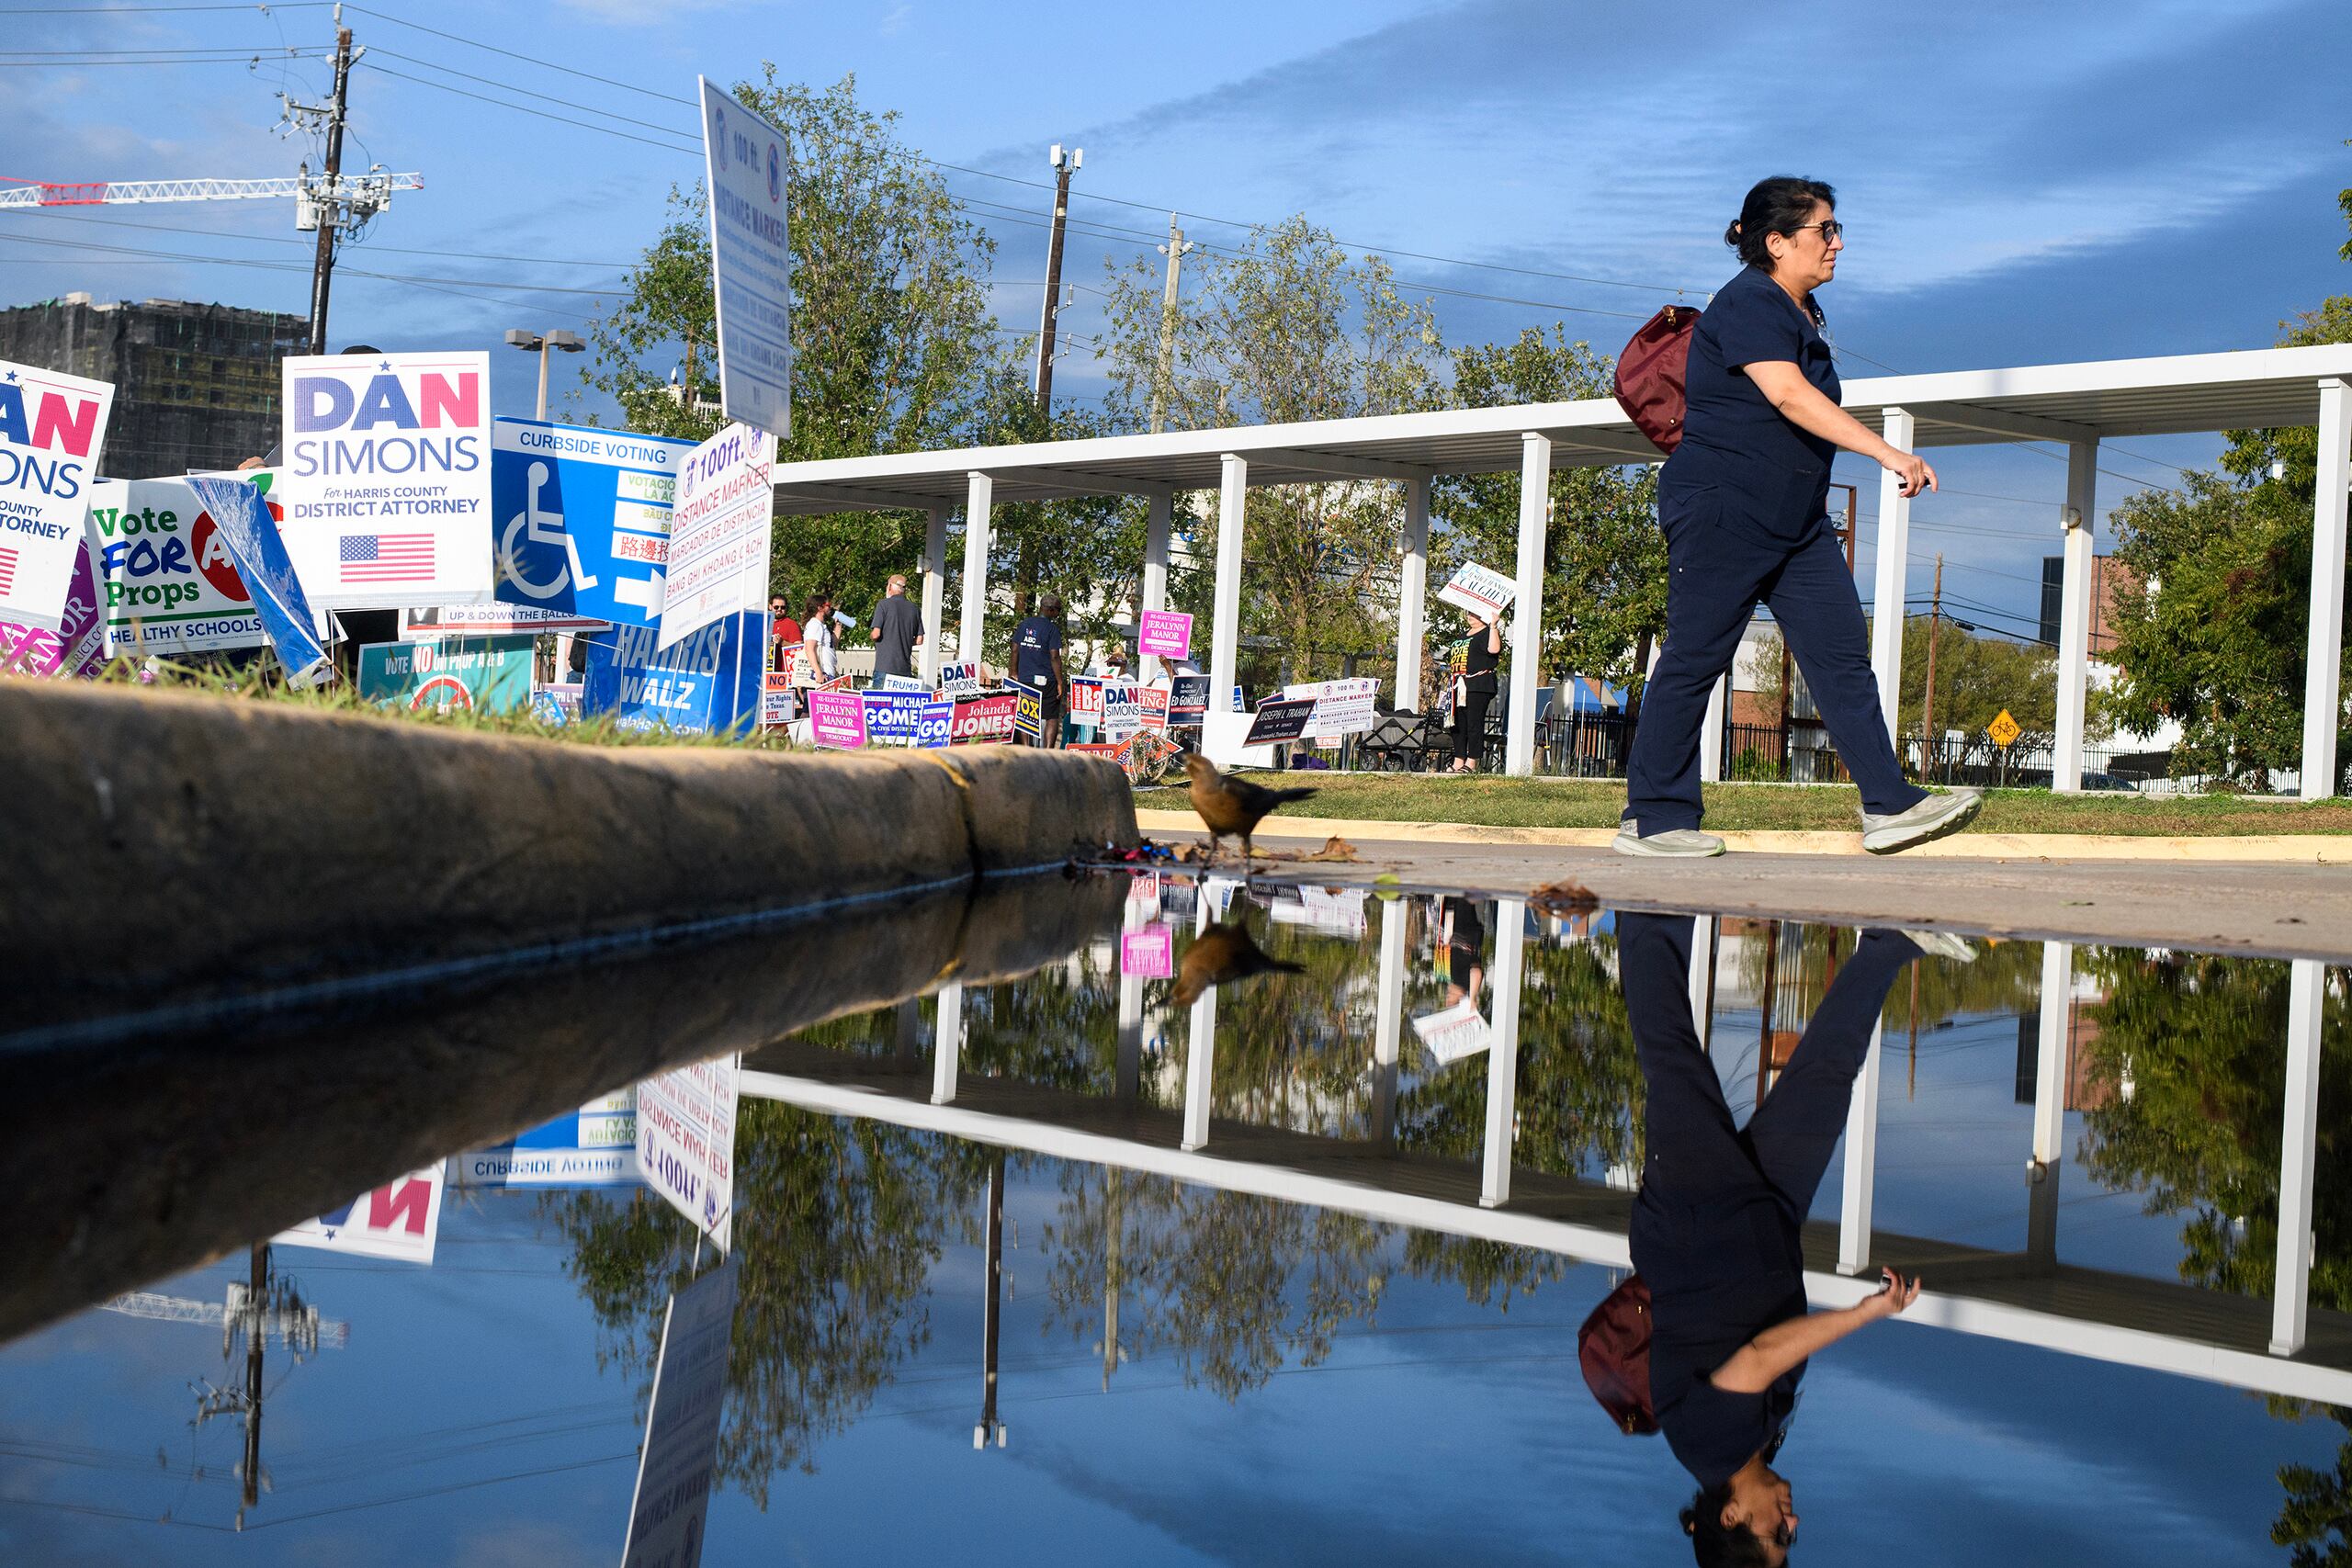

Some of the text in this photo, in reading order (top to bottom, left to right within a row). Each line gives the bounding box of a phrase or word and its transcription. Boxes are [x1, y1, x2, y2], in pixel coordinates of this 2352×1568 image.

[733, 130, 748, 166] 100
[752, 207, 786, 250] MARKER
[294, 373, 480, 433] DAN
[294, 435, 480, 477] SIMONS
[520, 432, 667, 464] CURBSIDE VOTING
[344, 488, 390, 499] HARRIS
[393, 486, 448, 498] COUNTY
[644, 490, 658, 501] LA
[673, 487, 719, 533] DISTANCE
[721, 462, 770, 502] MARKER
[294, 499, 480, 518] DISTRICT ATTORNEY
[92, 507, 178, 536] Vote
[671, 530, 709, 563] MARCADOR
[709, 521, 722, 540] DE
[723, 502, 766, 536] DISTANCIA
[99, 536, 192, 580] FOR
[687, 569, 701, 586] GHI
[104, 581, 200, 610] Props
[449, 609, 581, 621] UP & DOWN THE BALL
[110, 626, 180, 644] HEALTHY
[186, 617, 262, 638] SCHOOLS
[1146, 620, 1186, 632] JERALYNN
[1150, 629, 1180, 640] MANOR
[385, 656, 409, 675] VOTE
[412, 646, 434, 673] NO
[477, 650, 485, 669] A
[497, 649, 505, 667] B
[1451, 653, 1468, 664] OTE
[769, 675, 786, 686] NO
[943, 663, 976, 682] DAN
[621, 675, 695, 710] WALZ
[888, 679, 919, 692] TRUMP
[944, 679, 977, 694] SIMONS
[1104, 687, 1139, 705] DAN
[1170, 695, 1205, 706] ED GONZALEZ
[1319, 693, 1373, 705] DISTANCE MARKER
[766, 711, 779, 720] OTE
[816, 703, 858, 716] JERALYNN
[865, 707, 919, 726] GOME
[967, 703, 1011, 716] Jolanda
[1018, 696, 1039, 720] OX
[1106, 705, 1139, 716] SIMONS
[1257, 709, 1281, 722] JOSEPH
[1286, 707, 1311, 718] TRAHAN
[822, 715, 854, 728] MANOR
[952, 715, 1015, 737] JONES
[825, 733, 853, 742] DEMOCRAT
